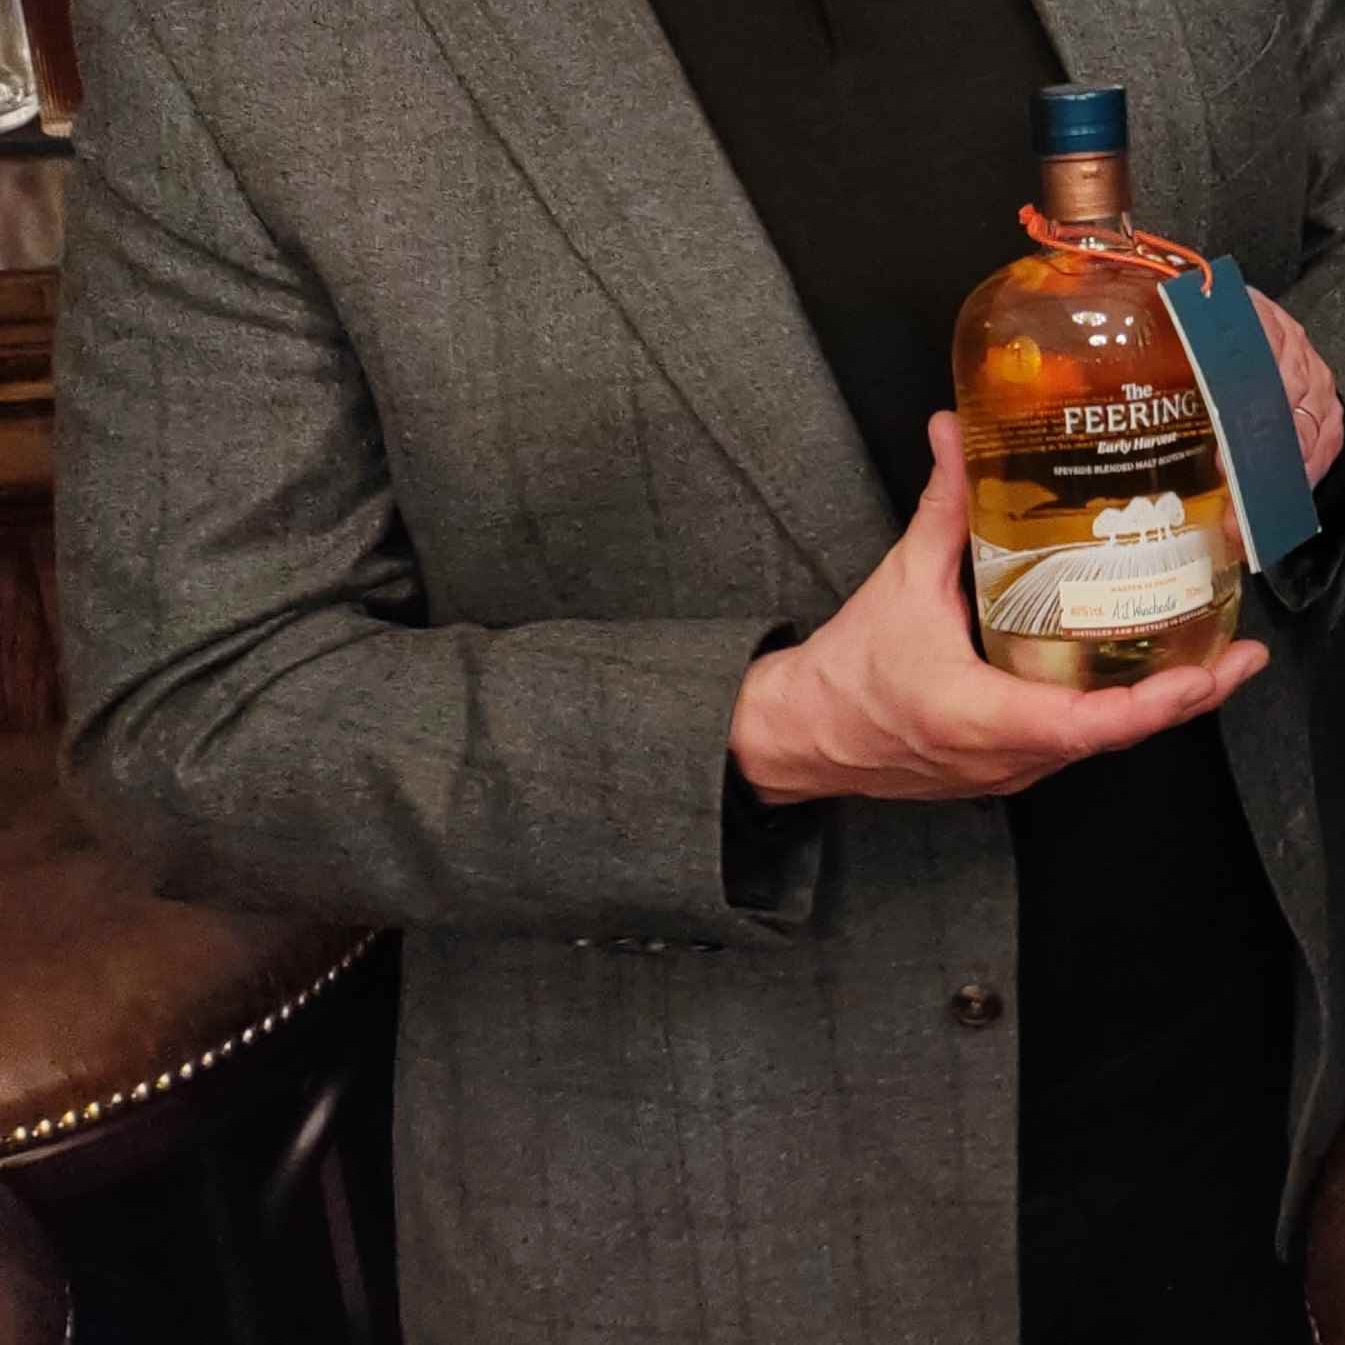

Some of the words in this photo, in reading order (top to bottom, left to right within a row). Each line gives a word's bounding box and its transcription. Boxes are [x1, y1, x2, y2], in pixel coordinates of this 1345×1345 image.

[1121, 383, 1153, 401] The
[1063, 390, 1197, 434] FEERING
[1097, 438, 1131, 455] Early
[1094, 462, 1134, 475] BLENDED
[1135, 458, 1158, 470] MALT
